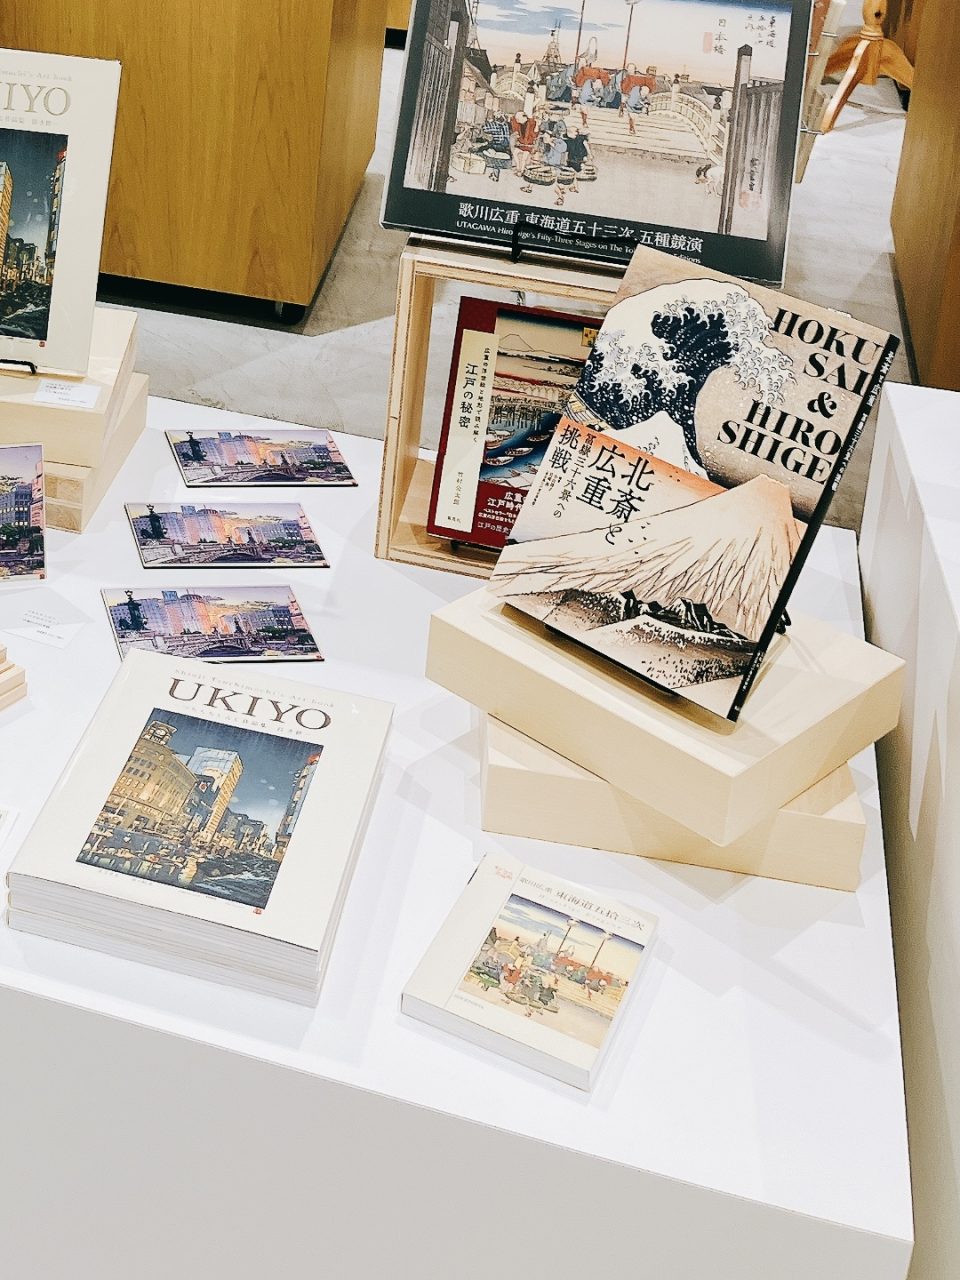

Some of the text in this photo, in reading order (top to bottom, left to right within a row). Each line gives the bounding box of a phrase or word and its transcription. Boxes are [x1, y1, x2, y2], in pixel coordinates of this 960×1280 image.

[456, 220, 496, 233] UTAGAWA
[537, 232, 574, 245] Fifty-Three
[575, 238, 597, 249] Stages
[609, 244, 623, 253] The
[458, 202, 520, 225] 歌川広重
[640, 230, 704, 253] 五種競演
[769, 307, 883, 365] HOKU
[458, 363, 478, 429] 江戸の秘密
[804, 352, 873, 397] SAI
[743, 399, 842, 456] HIRO
[807, 392, 837, 418] &
[549, 424, 582, 473] 挑戦
[717, 420, 832, 485] SHIGE
[576, 444, 625, 511] 広重
[605, 456, 655, 545] 北斎と
[168, 677, 332, 730] UKIYO
